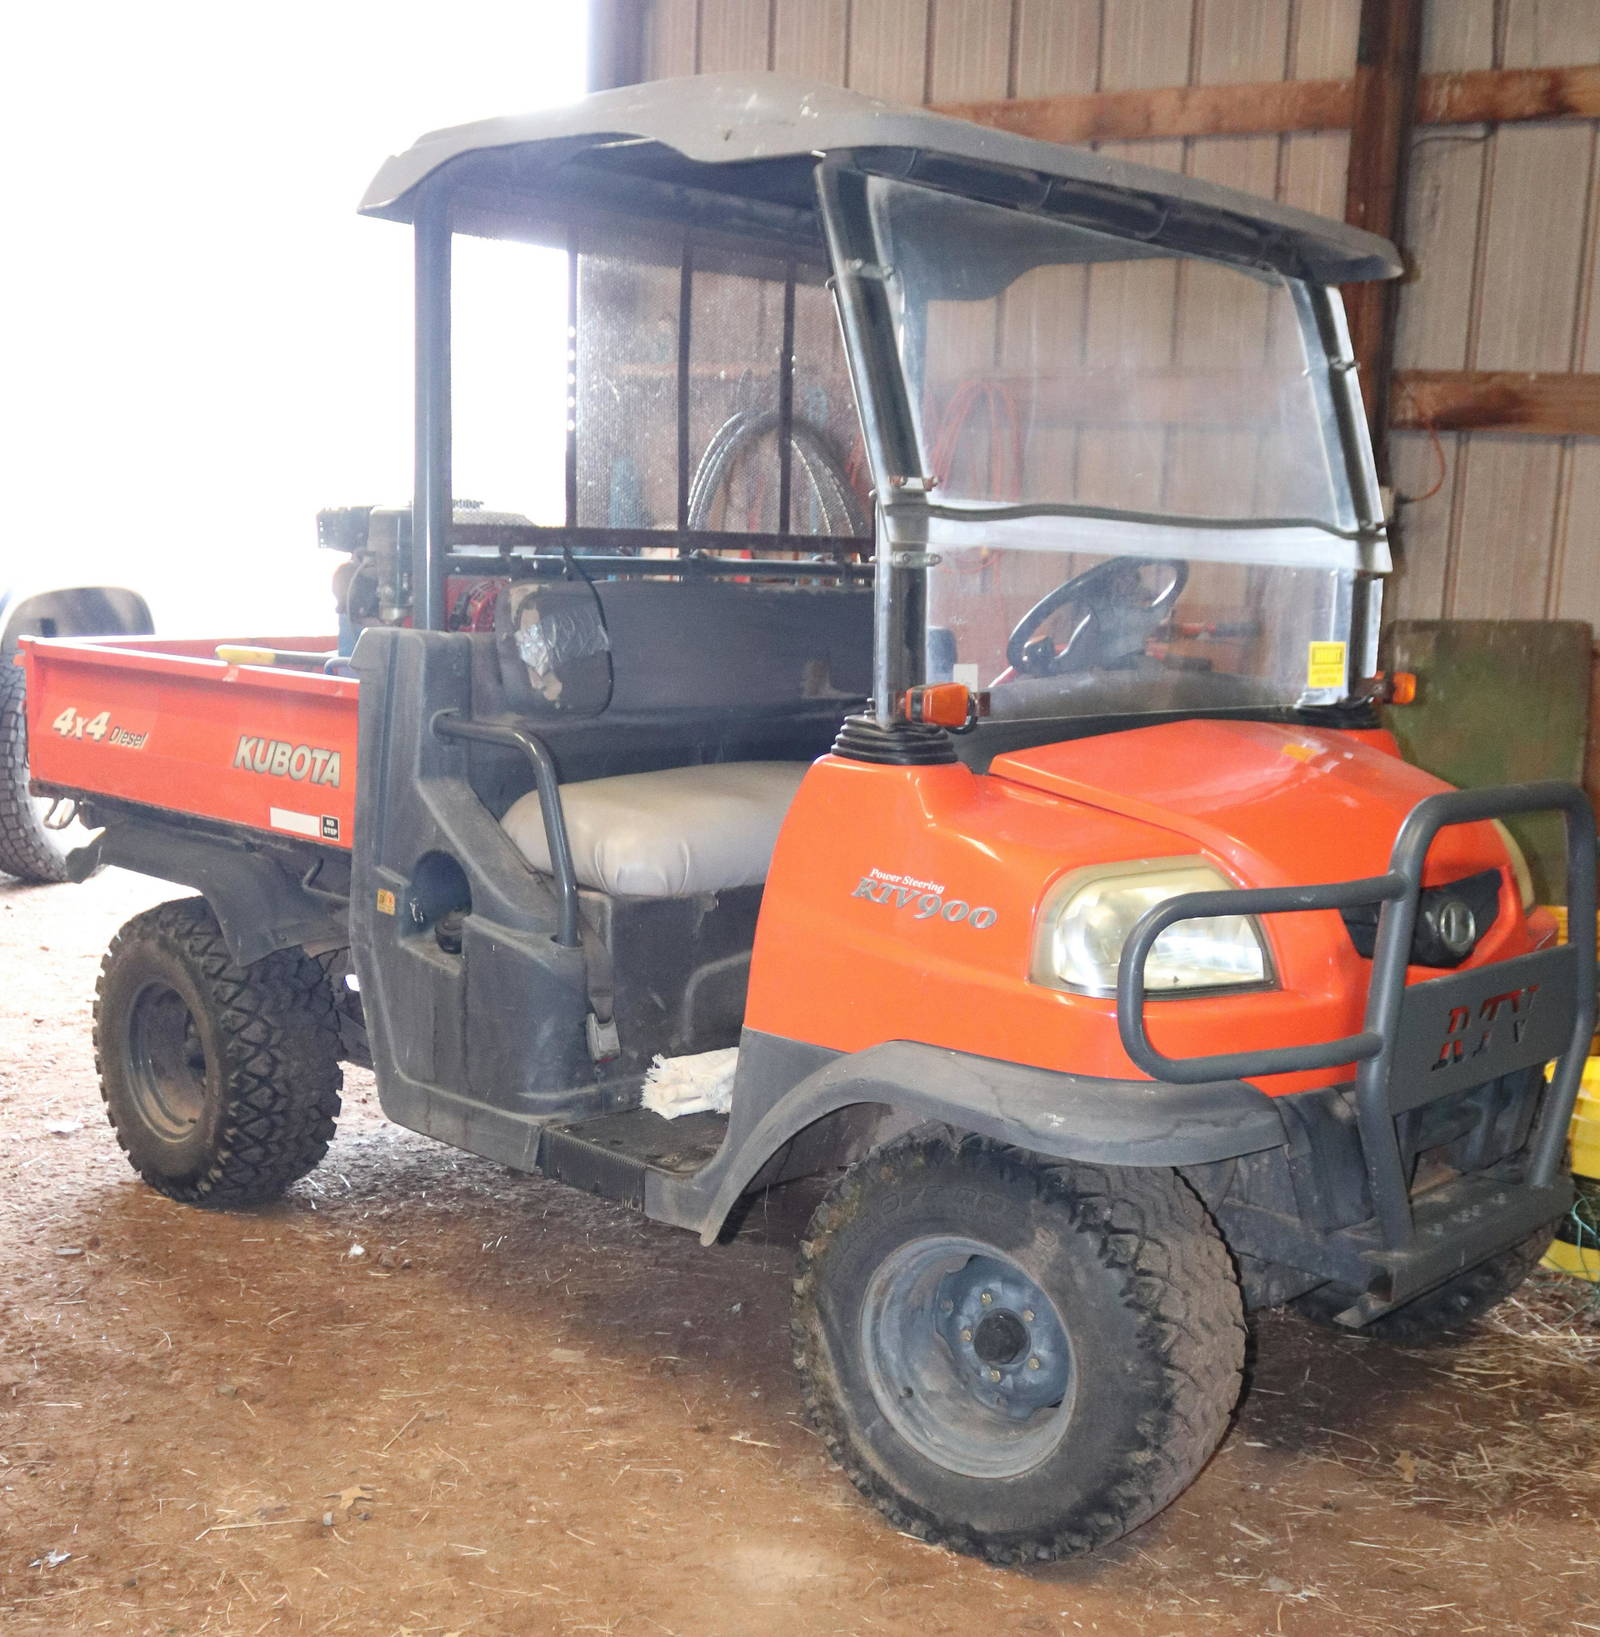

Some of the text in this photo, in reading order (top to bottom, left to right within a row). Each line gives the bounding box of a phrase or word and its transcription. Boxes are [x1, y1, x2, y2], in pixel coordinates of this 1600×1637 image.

[52, 707, 148, 749] 4x4 Diesel
[233, 735, 341, 788] KUBOTA
[324, 826, 338, 836] STEP
[850, 876, 998, 929] RTV900
[869, 867, 945, 895] Power Steering
[1431, 984, 1541, 1071] RTV
